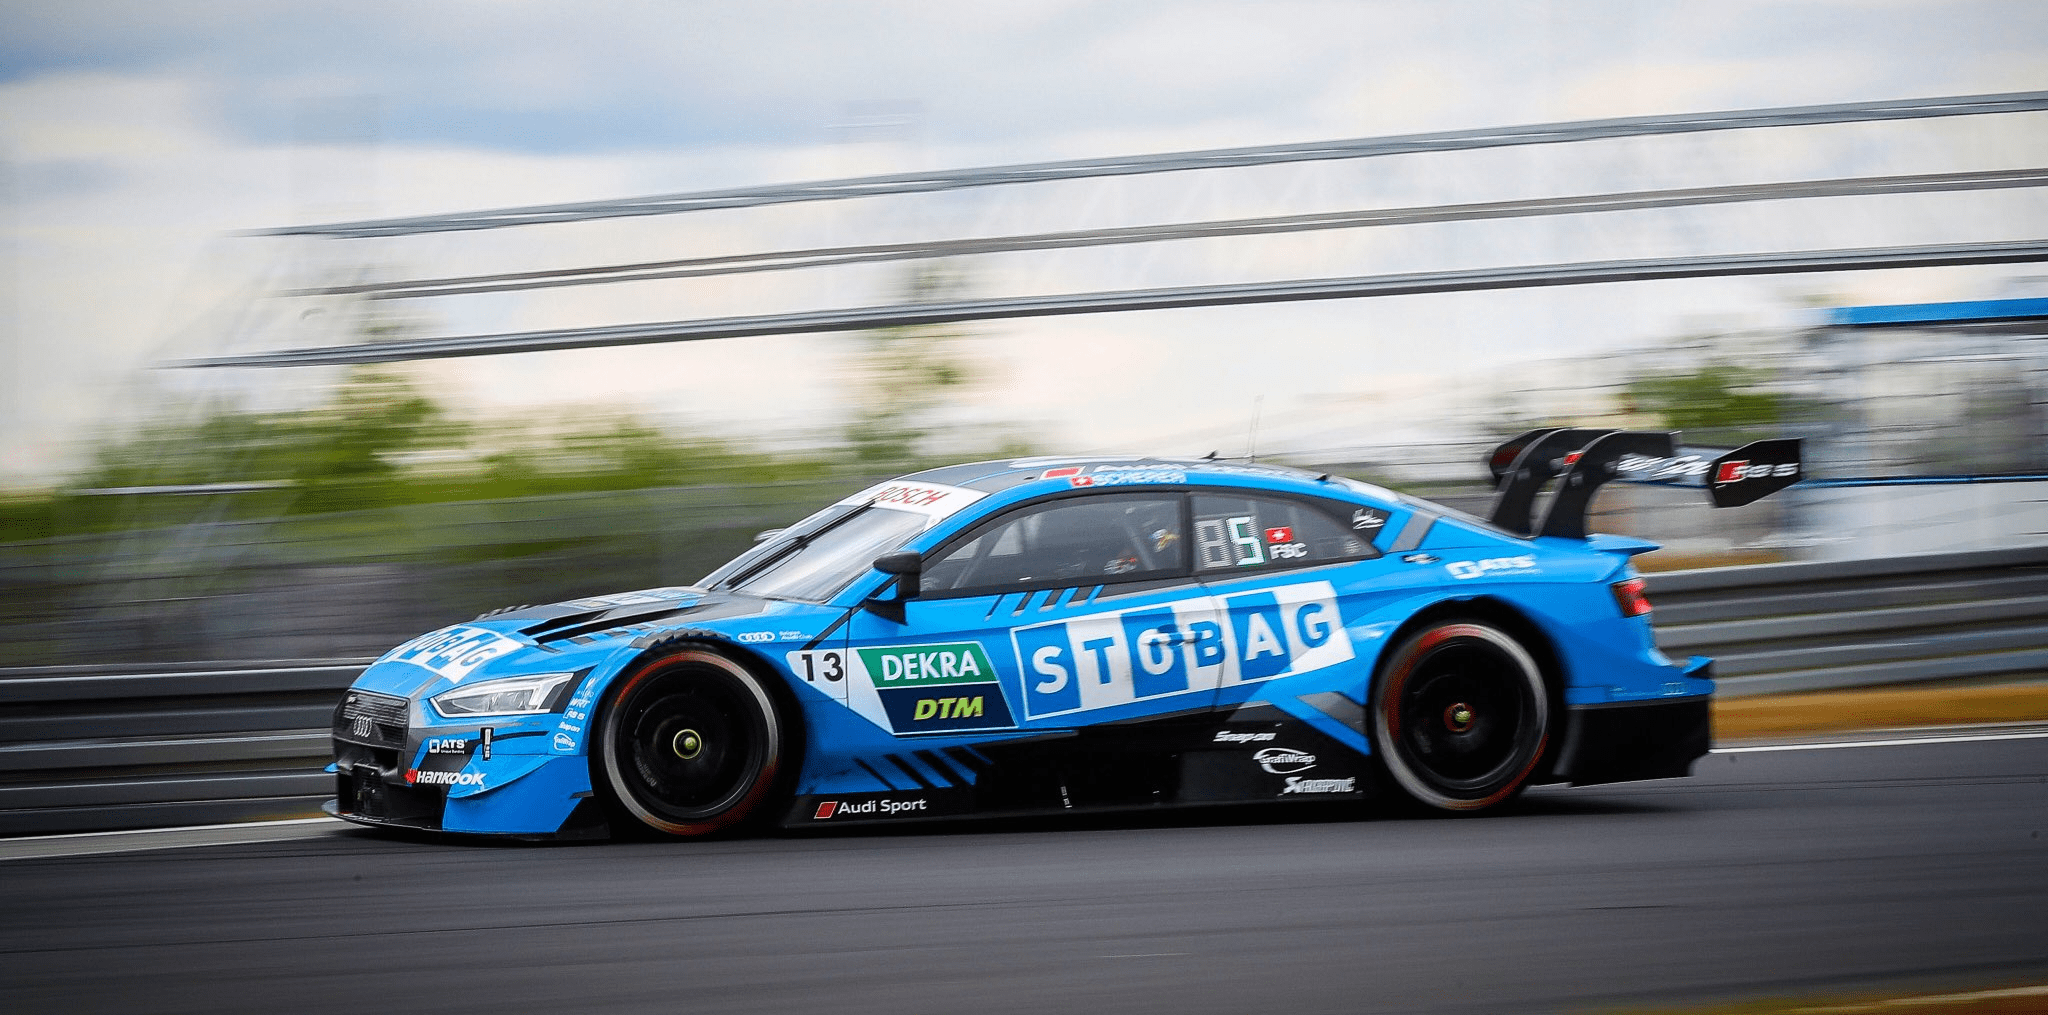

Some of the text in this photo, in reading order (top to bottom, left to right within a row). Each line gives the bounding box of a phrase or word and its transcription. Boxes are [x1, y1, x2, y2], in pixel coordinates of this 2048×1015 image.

[868, 486, 951, 506] BOSCH
[1269, 543, 1307, 560] FSC
[1031, 603, 1332, 694] STOBAG
[801, 652, 844, 682] 13
[882, 650, 981, 682] DEKRA
[913, 696, 984, 721] DTM
[440, 739, 465, 749] ATS
[838, 798, 927, 815] Audi Sport
